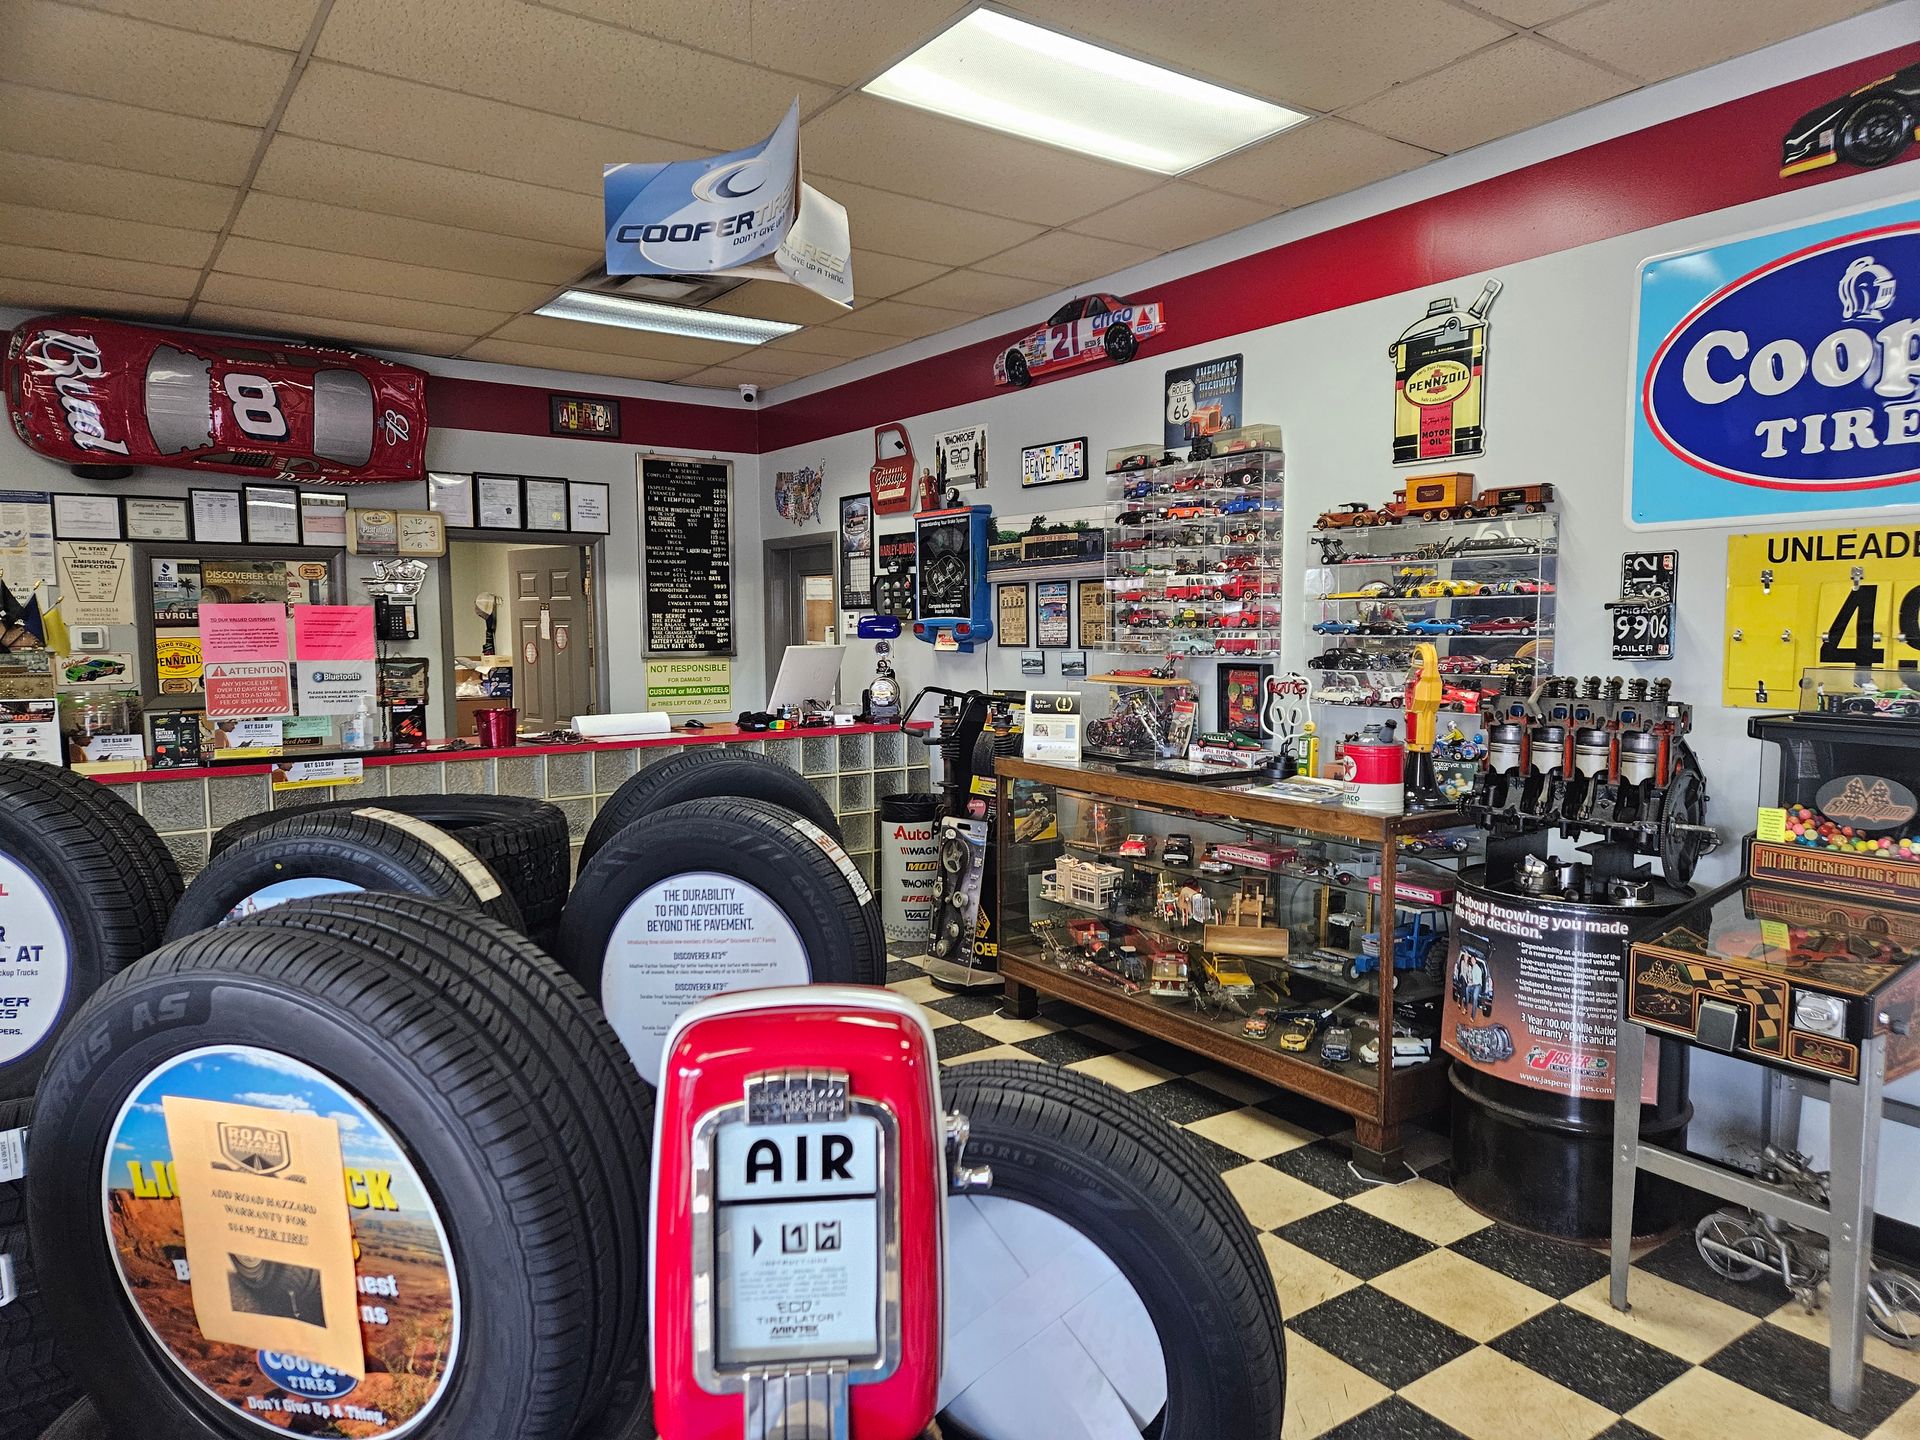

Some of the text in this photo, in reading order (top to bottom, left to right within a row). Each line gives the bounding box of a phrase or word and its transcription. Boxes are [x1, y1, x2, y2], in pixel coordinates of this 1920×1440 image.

[615, 210, 756, 244] COOPER
[733, 224, 776, 246] DON'T GIVE
[790, 253, 805, 266] GIVE
[806, 262, 816, 271] UP
[817, 266, 823, 275] A
[1091, 307, 1133, 329] CITGO
[1136, 323, 1154, 333] CITGO
[1051, 320, 1080, 361] 21
[1683, 318, 1920, 404] Coop
[1195, 359, 1238, 384] AMERICA'S
[1171, 383, 1191, 396] ROUTE
[1199, 376, 1237, 399] HIGHWAY
[1408, 370, 1469, 394] PENNZOIL
[42, 330, 130, 455] Bud
[224, 373, 290, 442] 8
[1173, 404, 1190, 421] 66
[1422, 429, 1450, 439] MOTOR
[1755, 401, 1920, 459] TIRE
[1429, 438, 1443, 446] OIL
[874, 471, 907, 493] Garage
[362, 526, 393, 534] Platinum
[1768, 531, 1920, 563] UNLEAD
[205, 570, 285, 582] DISCOVERER CTS
[155, 612, 198, 620] EVROLE
[1613, 644, 1654, 652] RAILER
[159, 654, 201, 667] ENNZOIL
[650, 663, 727, 673] NOT RESPONSIBLE
[228, 666, 284, 675] ATTENTION
[323, 672, 360, 680] Bluetooth
[649, 688, 677, 696] CUSTOM
[686, 687, 701, 695] MAG
[702, 686, 729, 694] WHEELS
[893, 825, 940, 841] AutoP
[909, 846, 939, 855] WAGN
[907, 862, 938, 871] MOO
[1761, 850, 1780, 868] HIT
[1780, 853, 1798, 871] THE
[1799, 857, 1855, 877] CHECKERD
[1857, 865, 1884, 881] FLAG
[1896, 872, 1920, 888] WIN
[906, 879, 936, 889] MONR
[663, 888, 735, 902] THE DURABILITY
[655, 903, 745, 917] TO FIND ADVENTURE
[1464, 895, 1489, 915] about
[1490, 901, 1550, 930] knowing
[1552, 917, 1582, 934] you
[1585, 918, 1629, 935] made
[647, 918, 754, 932] BEYOND THE PAVEMENT.
[1455, 904, 1544, 940] the right decision.
[16, 945, 43, 962] AT
[673, 952, 710, 960] DISCOVERER
[1521, 942, 1563, 956] Dependability
[1520, 957, 1546, 967] Live-run
[1593, 959, 1615, 967] vehicle
[16, 968, 39, 976] Trucks
[1519, 970, 1551, 981] automatic
[674, 983, 712, 991] DISCOVERER
[1519, 978, 1571, 993] Updated avoid
[1517, 993, 1554, 1007] No monthly
[1519, 985, 1617, 1006] with problems design
[1521, 1013, 1526, 1022] 3
[1594, 1024, 1617, 1036] Natio
[1528, 1024, 1604, 1045] Warranty Parts and
[1531, 1048, 1592, 1070] JASPER
[227, 1127, 280, 1144] ROAD
[745, 1134, 855, 1184] AIR
[224, 1203, 283, 1223] WARRANTY
[287, 1375, 337, 1393] TIRES
[247, 1396, 388, 1426] Don't Give Up A Thing.
